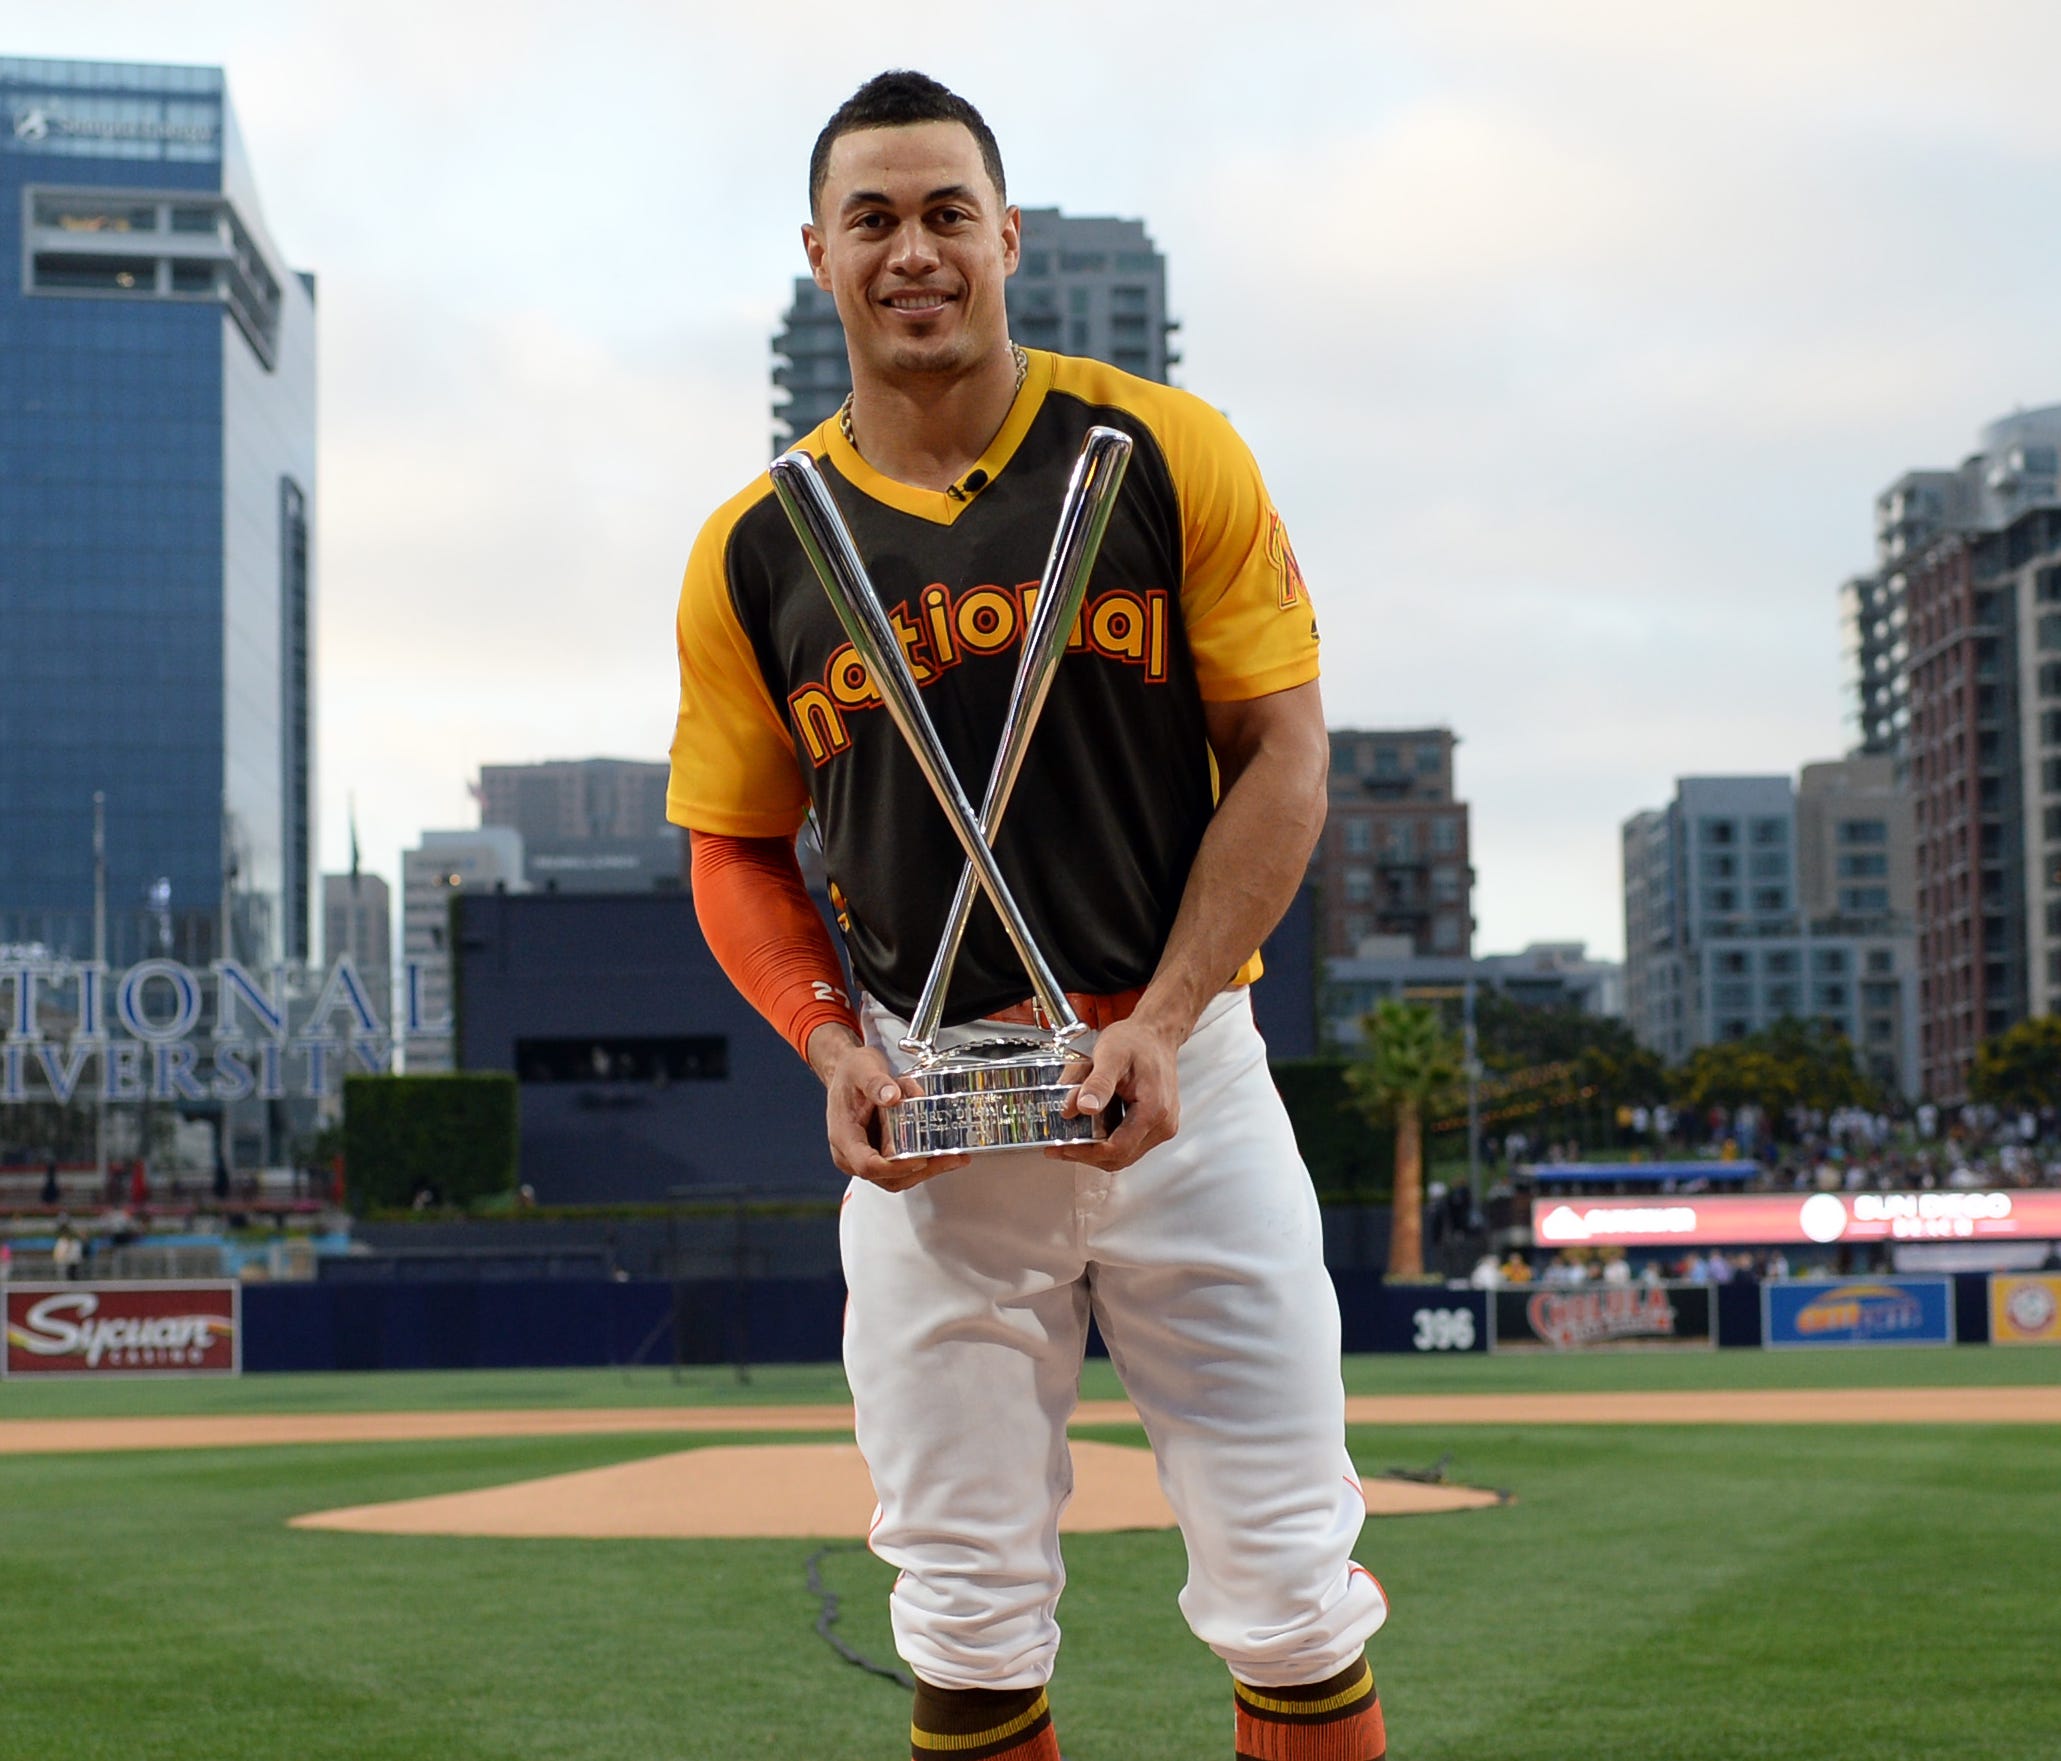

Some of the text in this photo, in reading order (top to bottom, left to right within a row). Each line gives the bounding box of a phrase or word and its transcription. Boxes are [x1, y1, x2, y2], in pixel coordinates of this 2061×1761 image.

[0, 953, 452, 1042] TIONAL
[26, 1293, 215, 1368] Sycuan
[1413, 1308, 1475, 1350] 396
